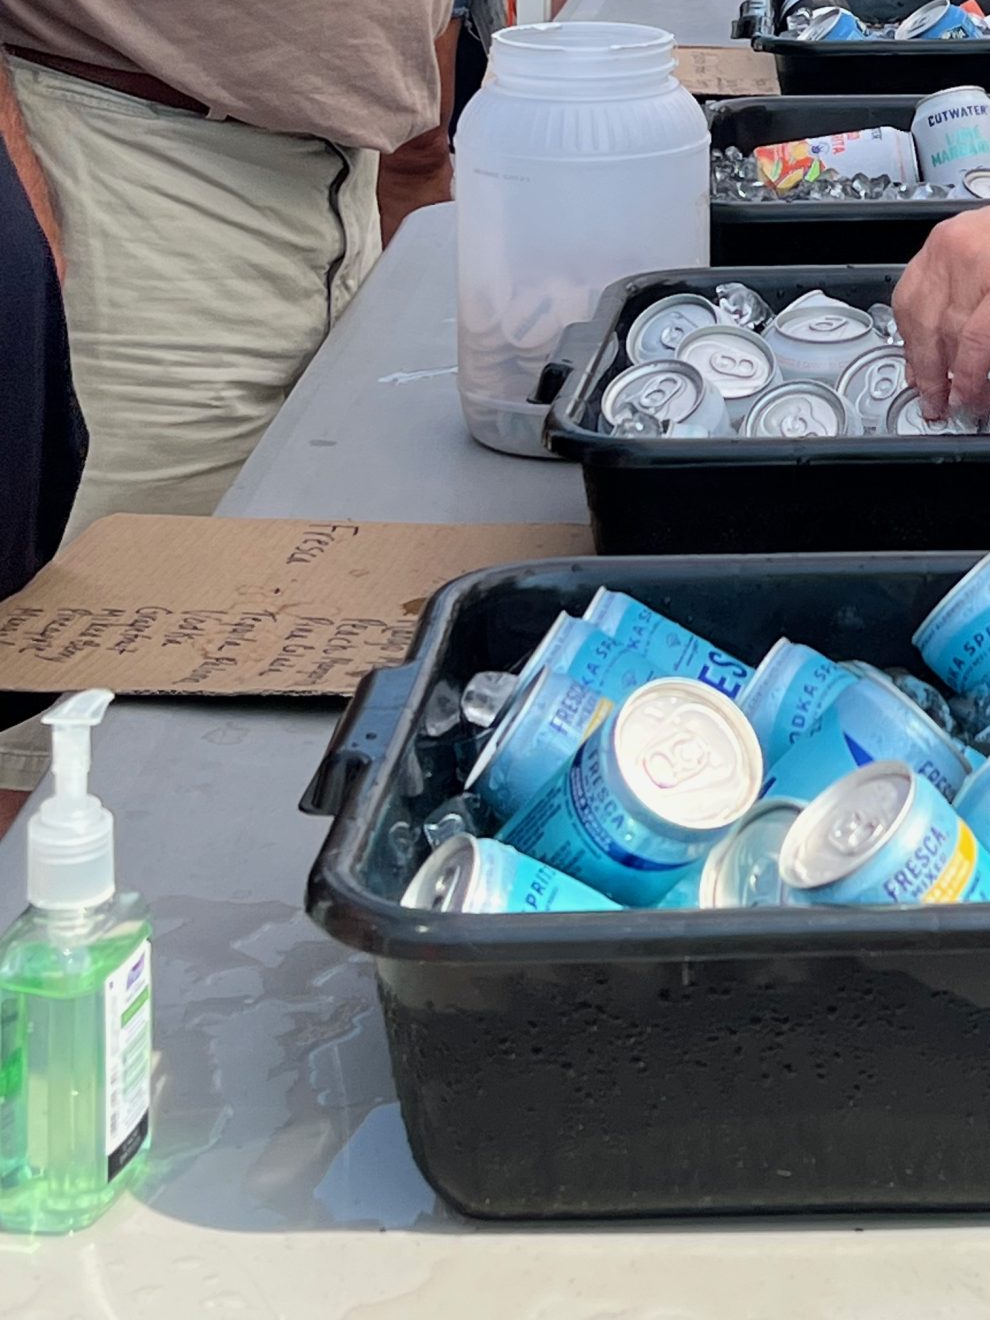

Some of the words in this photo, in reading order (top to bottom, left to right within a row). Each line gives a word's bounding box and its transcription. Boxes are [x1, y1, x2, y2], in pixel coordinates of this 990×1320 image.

[928, 105, 988, 128] CUTWATER
[286, 524, 359, 565] Fresca
[161, 610, 228, 647] Vodka
[587, 748, 625, 831] FRESCA
[883, 826, 947, 903] FRESCA
